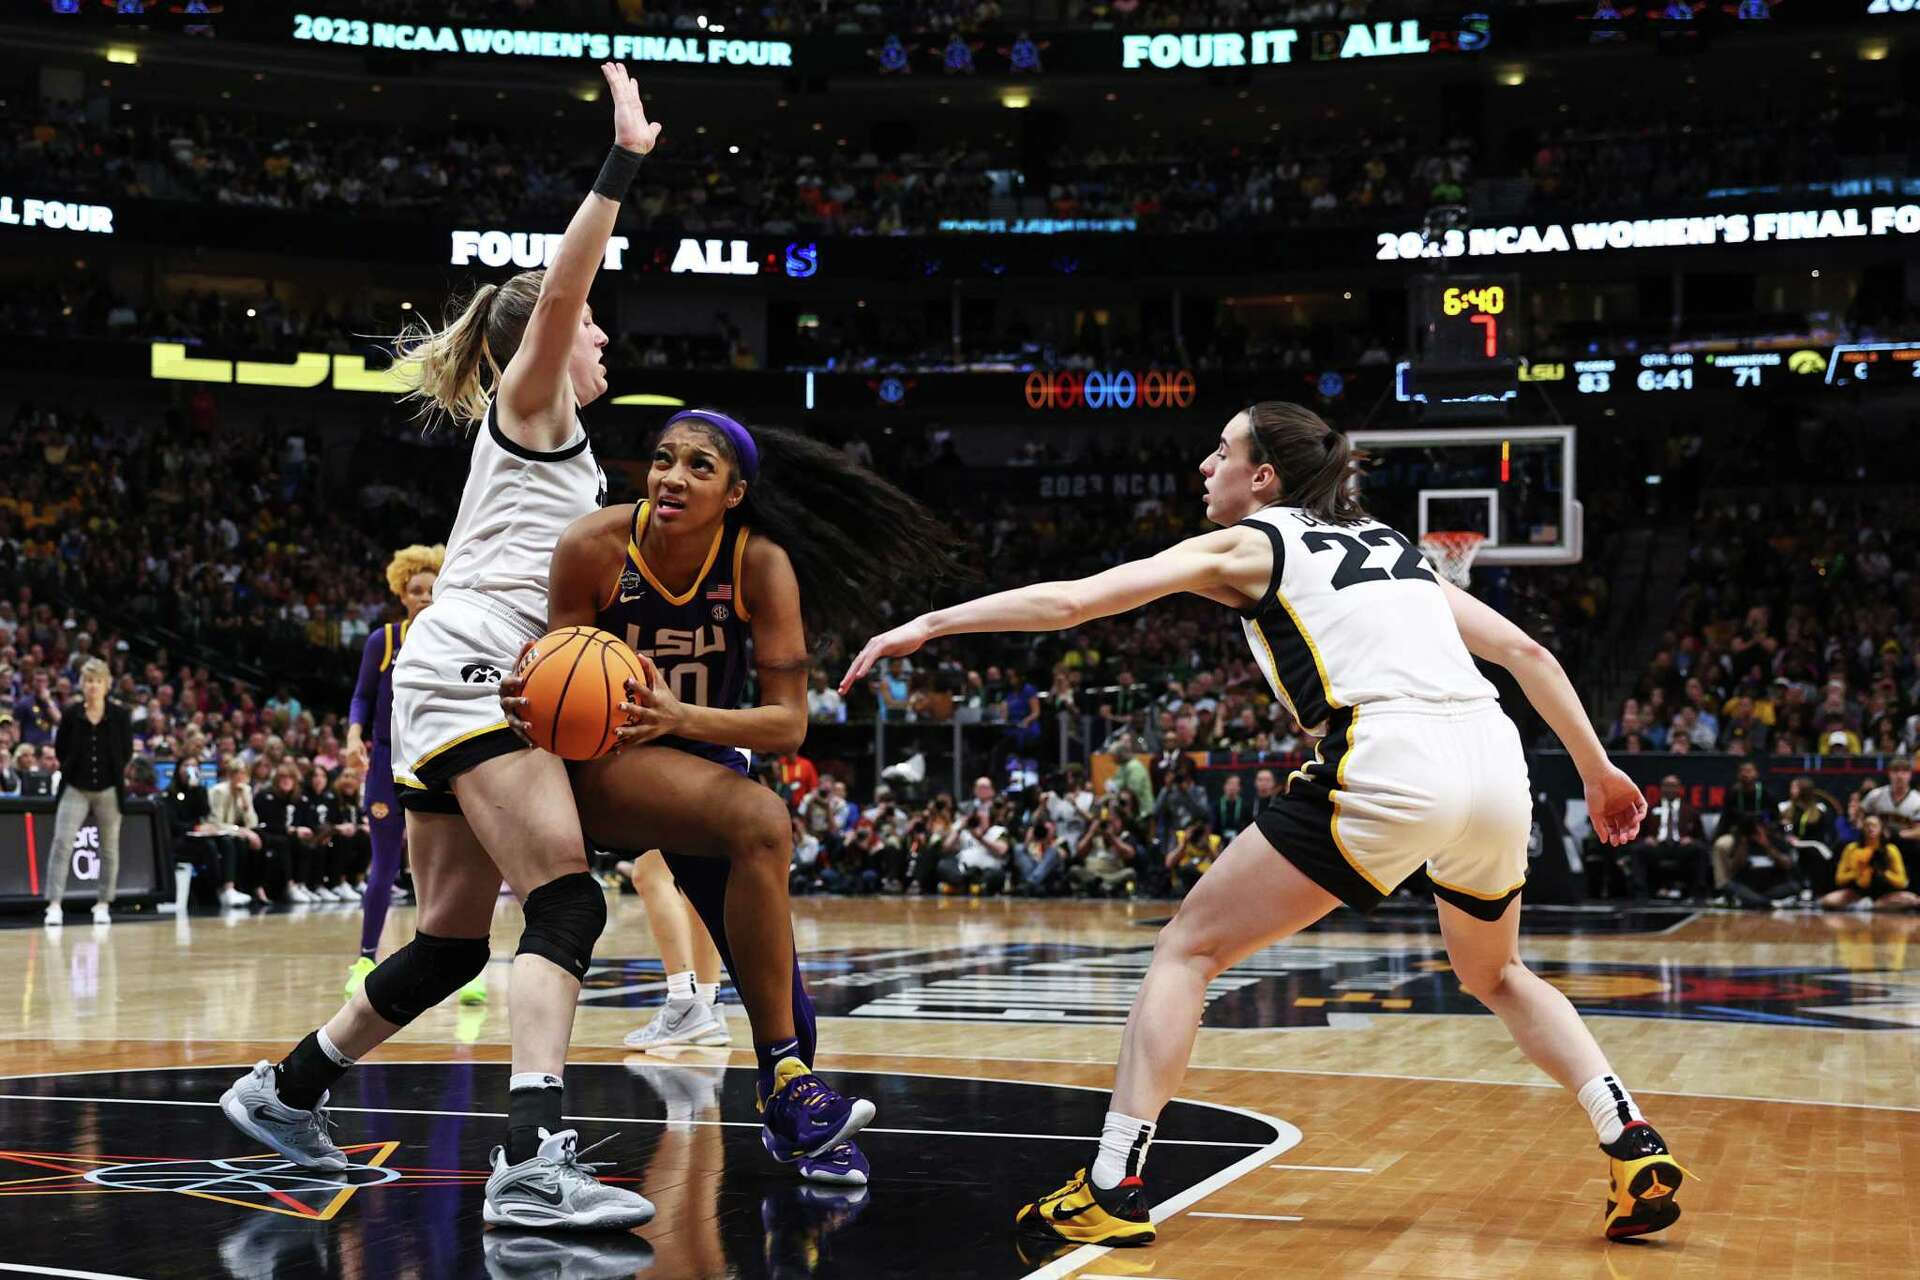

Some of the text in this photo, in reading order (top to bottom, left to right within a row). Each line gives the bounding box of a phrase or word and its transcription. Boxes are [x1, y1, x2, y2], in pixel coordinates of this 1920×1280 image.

[293, 14, 792, 66] 2023 NCAA WOMEN'S FINAL FOUR
[1122, 33, 1246, 69] FOUR
[1251, 29, 1298, 64] IT
[23, 198, 114, 234] FOUR
[1468, 224, 1570, 256] NCAA
[1571, 214, 1750, 250] WOMEN'S
[1753, 208, 1867, 242] FINAL
[1443, 286, 1504, 316] 6:40
[1470, 314, 1497, 357] 7
[1518, 364, 1565, 381] LSU
[1577, 372, 1610, 393] 83
[1637, 368, 1693, 391] 6:41
[1733, 366, 1761, 387] 71
[1300, 528, 1441, 591] 22
[626, 623, 726, 659] LSU
